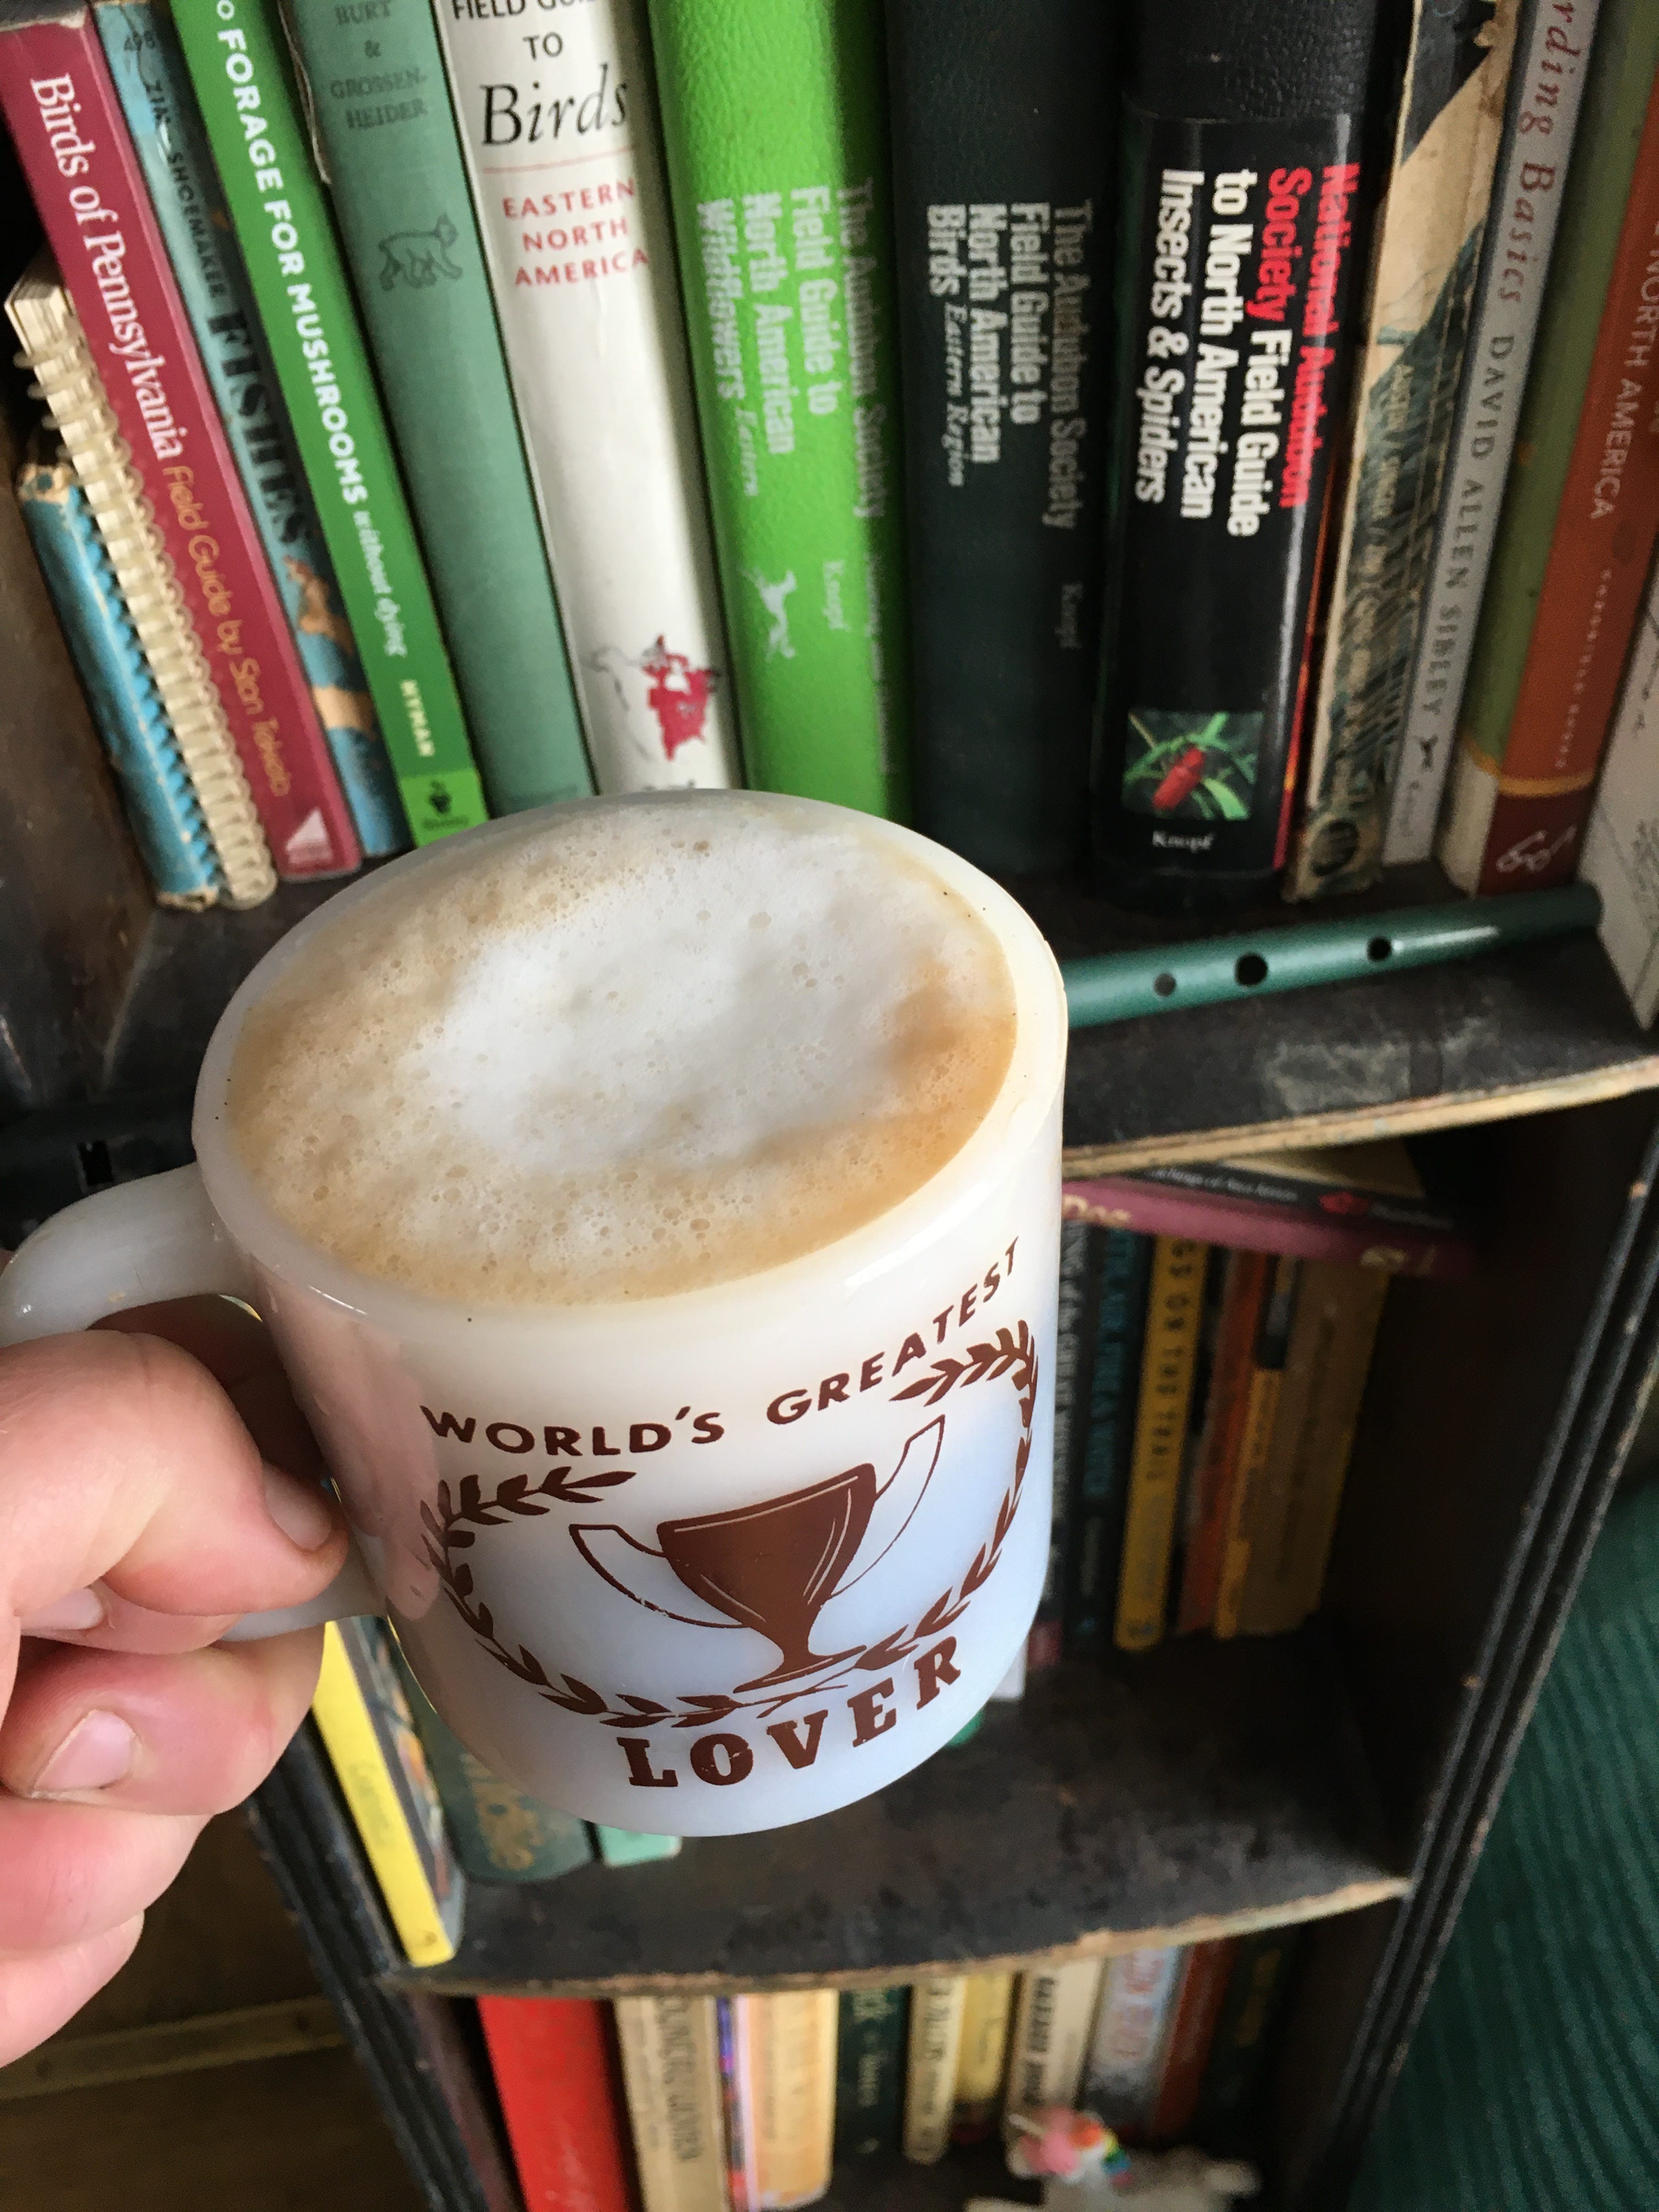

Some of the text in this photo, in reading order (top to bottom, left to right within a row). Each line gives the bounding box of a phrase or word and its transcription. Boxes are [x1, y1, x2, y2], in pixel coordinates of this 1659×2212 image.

[479, 63, 628, 147] Birds
[522, 31, 563, 60] TO
[30, 73, 95, 177] Birds
[69, 185, 119, 225] of
[501, 178, 636, 218] EASTERN
[514, 249, 650, 287] AMERICA
[522, 216, 629, 253] NORTH
[927, 205, 967, 297] Birds
[1498, 161, 1556, 303] Basics
[83, 231, 189, 460] Pennsylvania
[219, 29, 283, 192] FORAGE
[264, 200, 306, 276] FOR
[287, 284, 369, 504] MUSHROOMS
[353, 510, 393, 593] without
[742, 192, 799, 455] North American
[791, 186, 843, 415] Field Guide to
[969, 204, 1008, 463] North American
[1011, 202, 1049, 424] Field Guide to
[1042, 200, 1092, 529] The Audubon Society
[1135, 169, 1205, 503] Insects & Spiders
[1180, 168, 1258, 520] to North American
[1227, 167, 1313, 538] Society Field Guide
[1279, 163, 1360, 508] National Audubon
[1470, 334, 1515, 460] DAVID
[1590, 377, 1642, 520] AMERICA
[163, 466, 208, 530] Field
[1444, 479, 1485, 589] ALLEN
[190, 535, 232, 617] Guide
[217, 619, 243, 656] by
[1422, 604, 1464, 715] SIBLEY
[420, 1405, 725, 1457] WORLD'S
[766, 1236, 1019, 1425] GREATEST
[616, 1635, 962, 1788] LOVER
